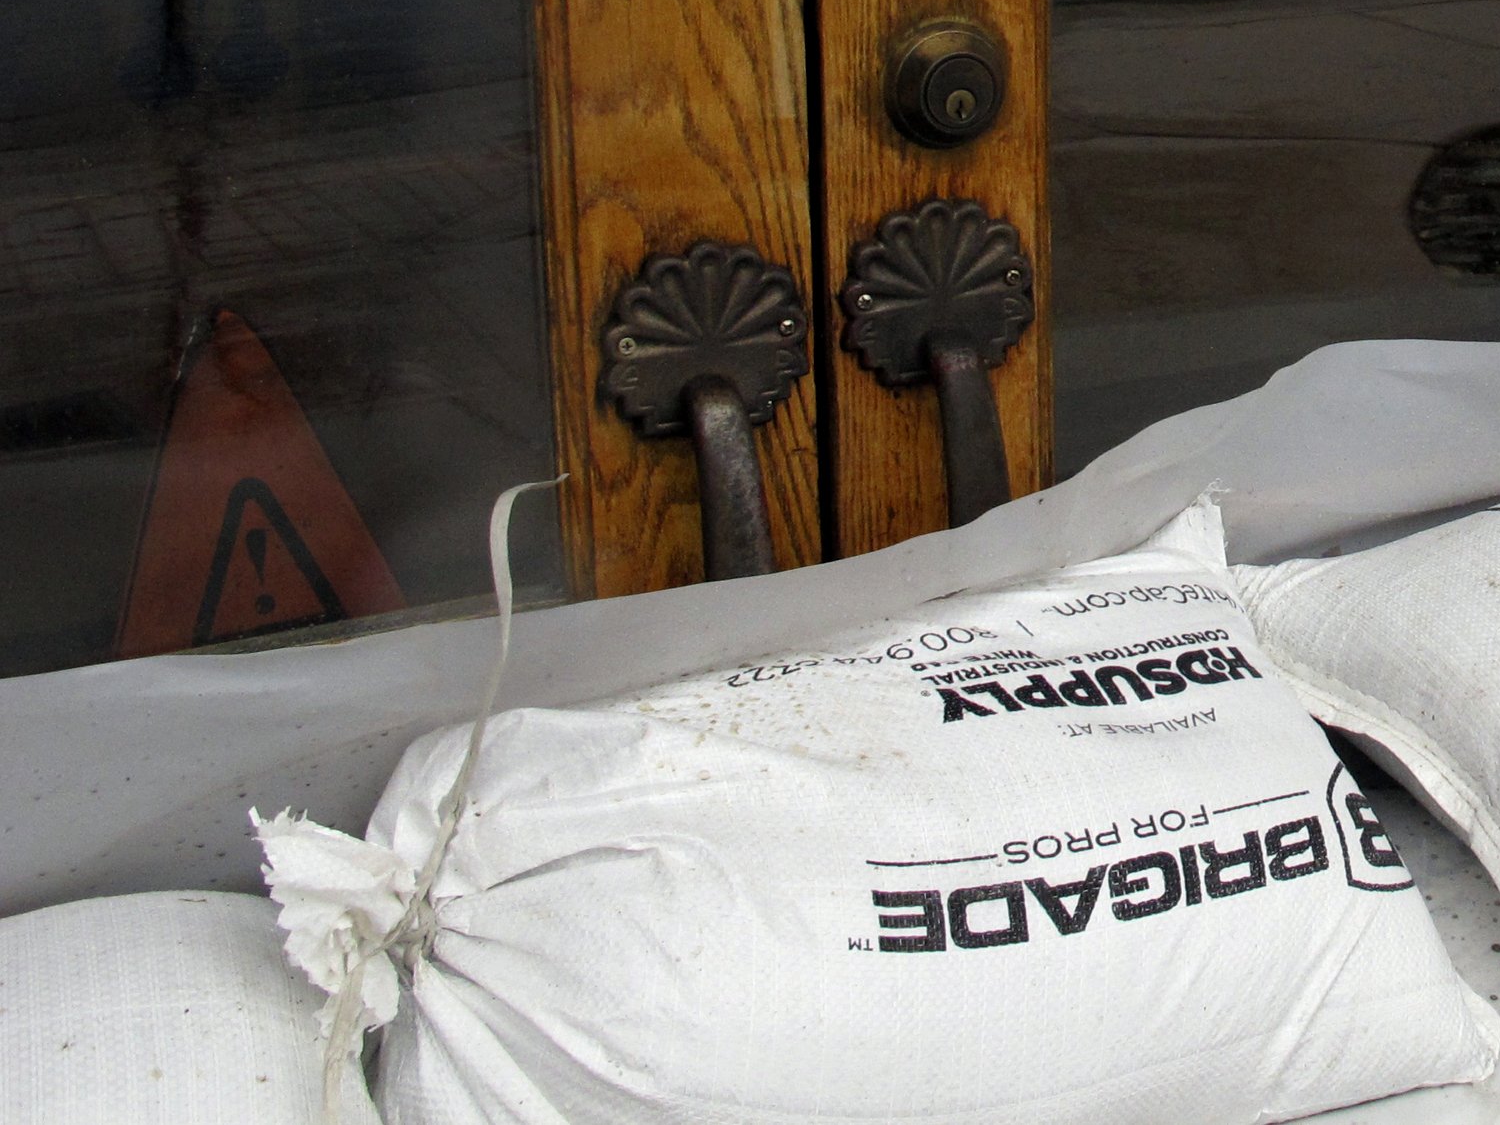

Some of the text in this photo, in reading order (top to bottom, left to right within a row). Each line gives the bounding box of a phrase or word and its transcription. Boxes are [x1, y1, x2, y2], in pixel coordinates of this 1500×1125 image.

[1084, 628, 1230, 664] CONSTRUCTION
[921, 658, 1067, 686] INDUSTRIAL
[1099, 707, 1217, 735] AVAILABLE
[1003, 804, 1211, 865] FOR PROS
[871, 814, 1330, 953] BRIGADE
